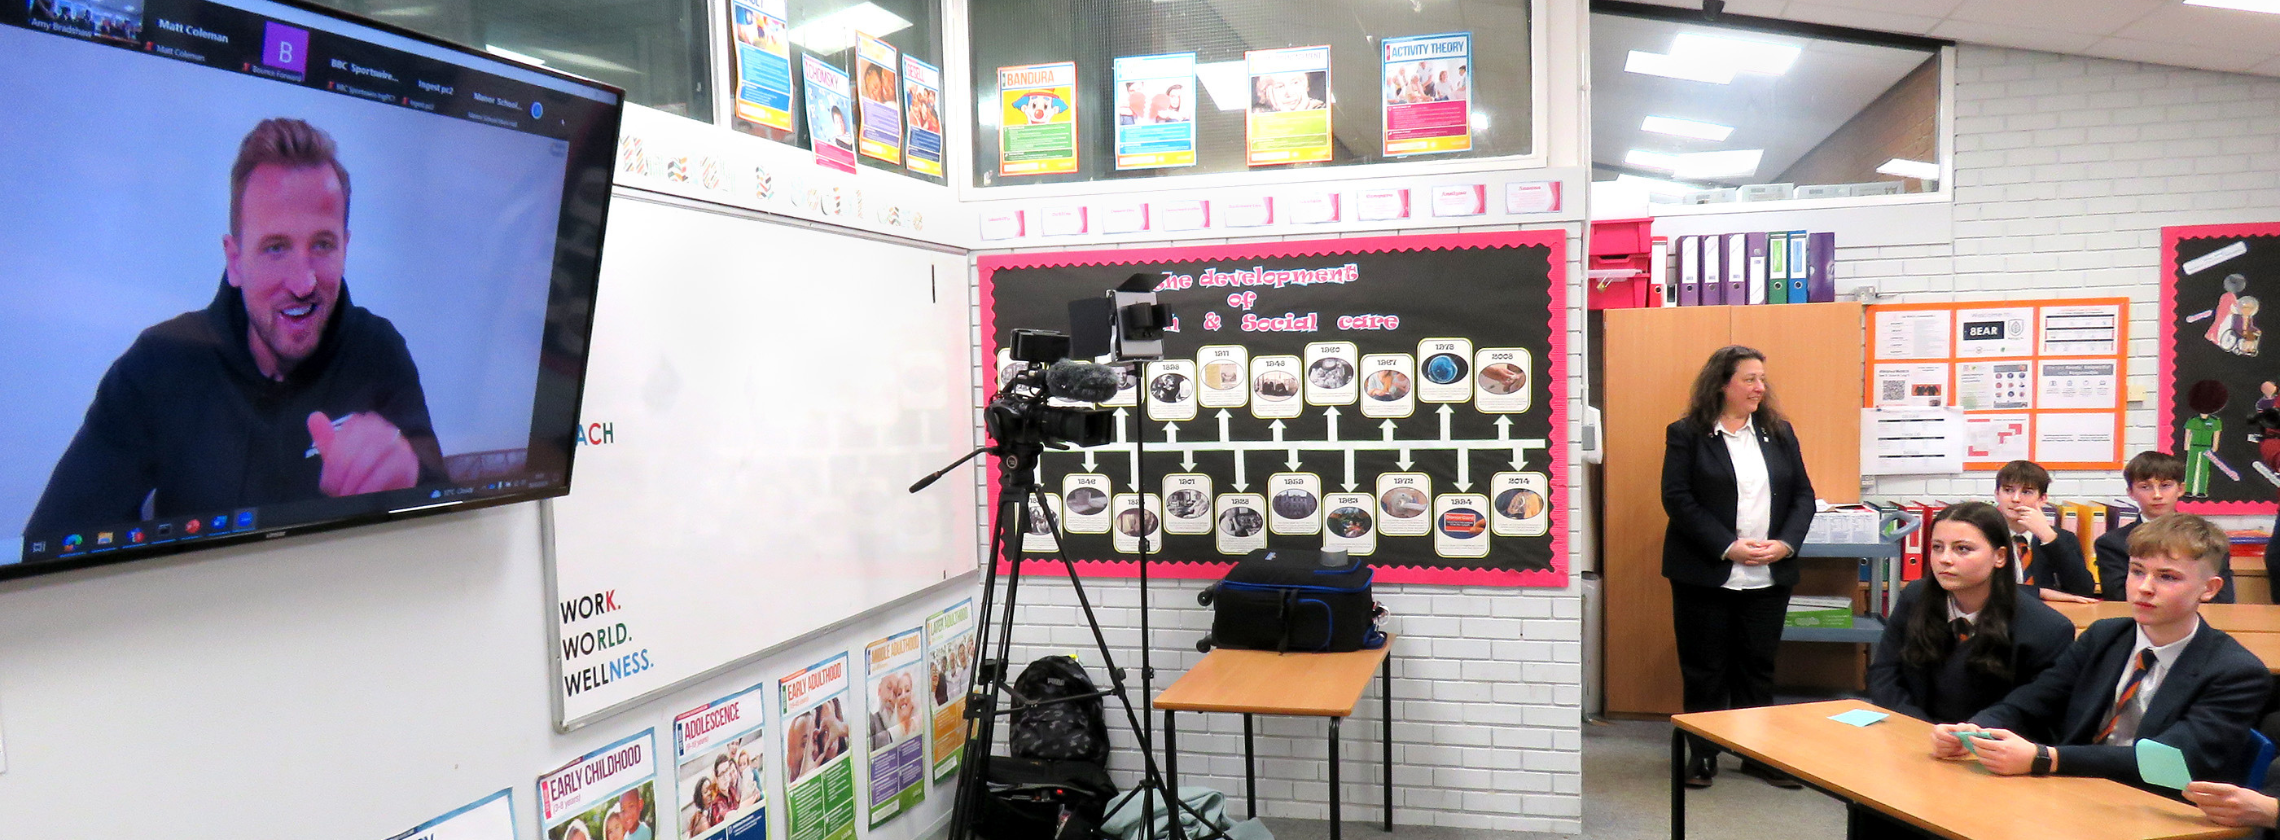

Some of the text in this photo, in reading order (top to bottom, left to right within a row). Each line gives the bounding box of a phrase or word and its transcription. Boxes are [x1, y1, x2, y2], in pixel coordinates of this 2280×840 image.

[158, 19, 229, 43] Matt Coleman
[279, 41, 292, 63] B
[1391, 40, 1465, 58] ACTIVITY THEORY
[331, 58, 349, 71] BBC
[907, 64, 925, 83] GESELL
[1006, 70, 1054, 86] BANDURA
[1199, 262, 1359, 288] development
[1227, 291, 1257, 311] of
[1203, 311, 1221, 332] &
[1241, 311, 1318, 333] Social
[1337, 313, 1399, 331] care
[575, 422, 614, 448] ACH
[560, 589, 622, 624] WORK.
[562, 622, 633, 661] WORLD.
[891, 634, 920, 657] ADULTHOOD
[564, 648, 654, 698] WELLNESS.
[787, 662, 842, 701] EARLY ADULTHOOD
[684, 701, 740, 742] ADOLESCENCE
[549, 744, 642, 802] EARLY CHILDHOOD
